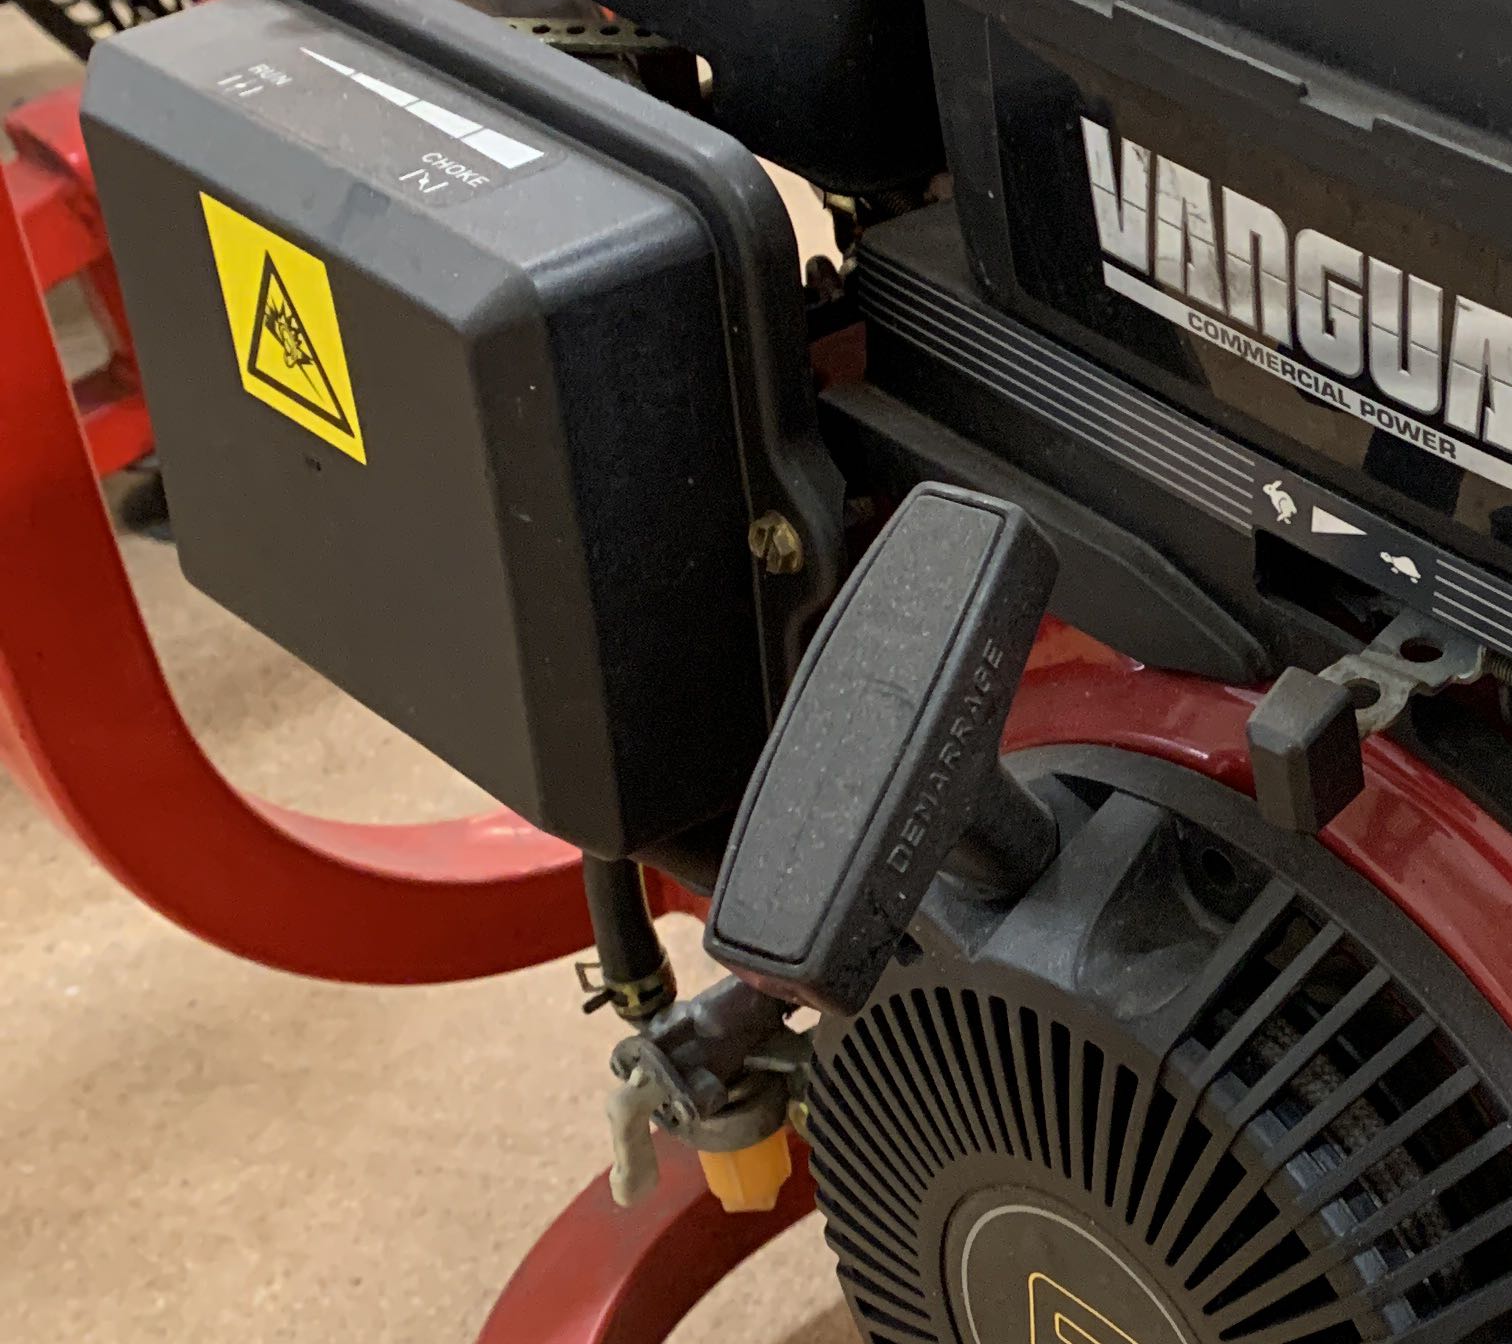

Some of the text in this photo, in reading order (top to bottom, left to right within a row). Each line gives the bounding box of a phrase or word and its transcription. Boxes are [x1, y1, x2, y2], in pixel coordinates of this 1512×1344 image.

[248, 63, 292, 87] RUN
[421, 152, 490, 188] CHOKE
[1187, 311, 1457, 460] COMMERCIAL POWER
[886, 637, 1005, 874] DEMARRAGE
